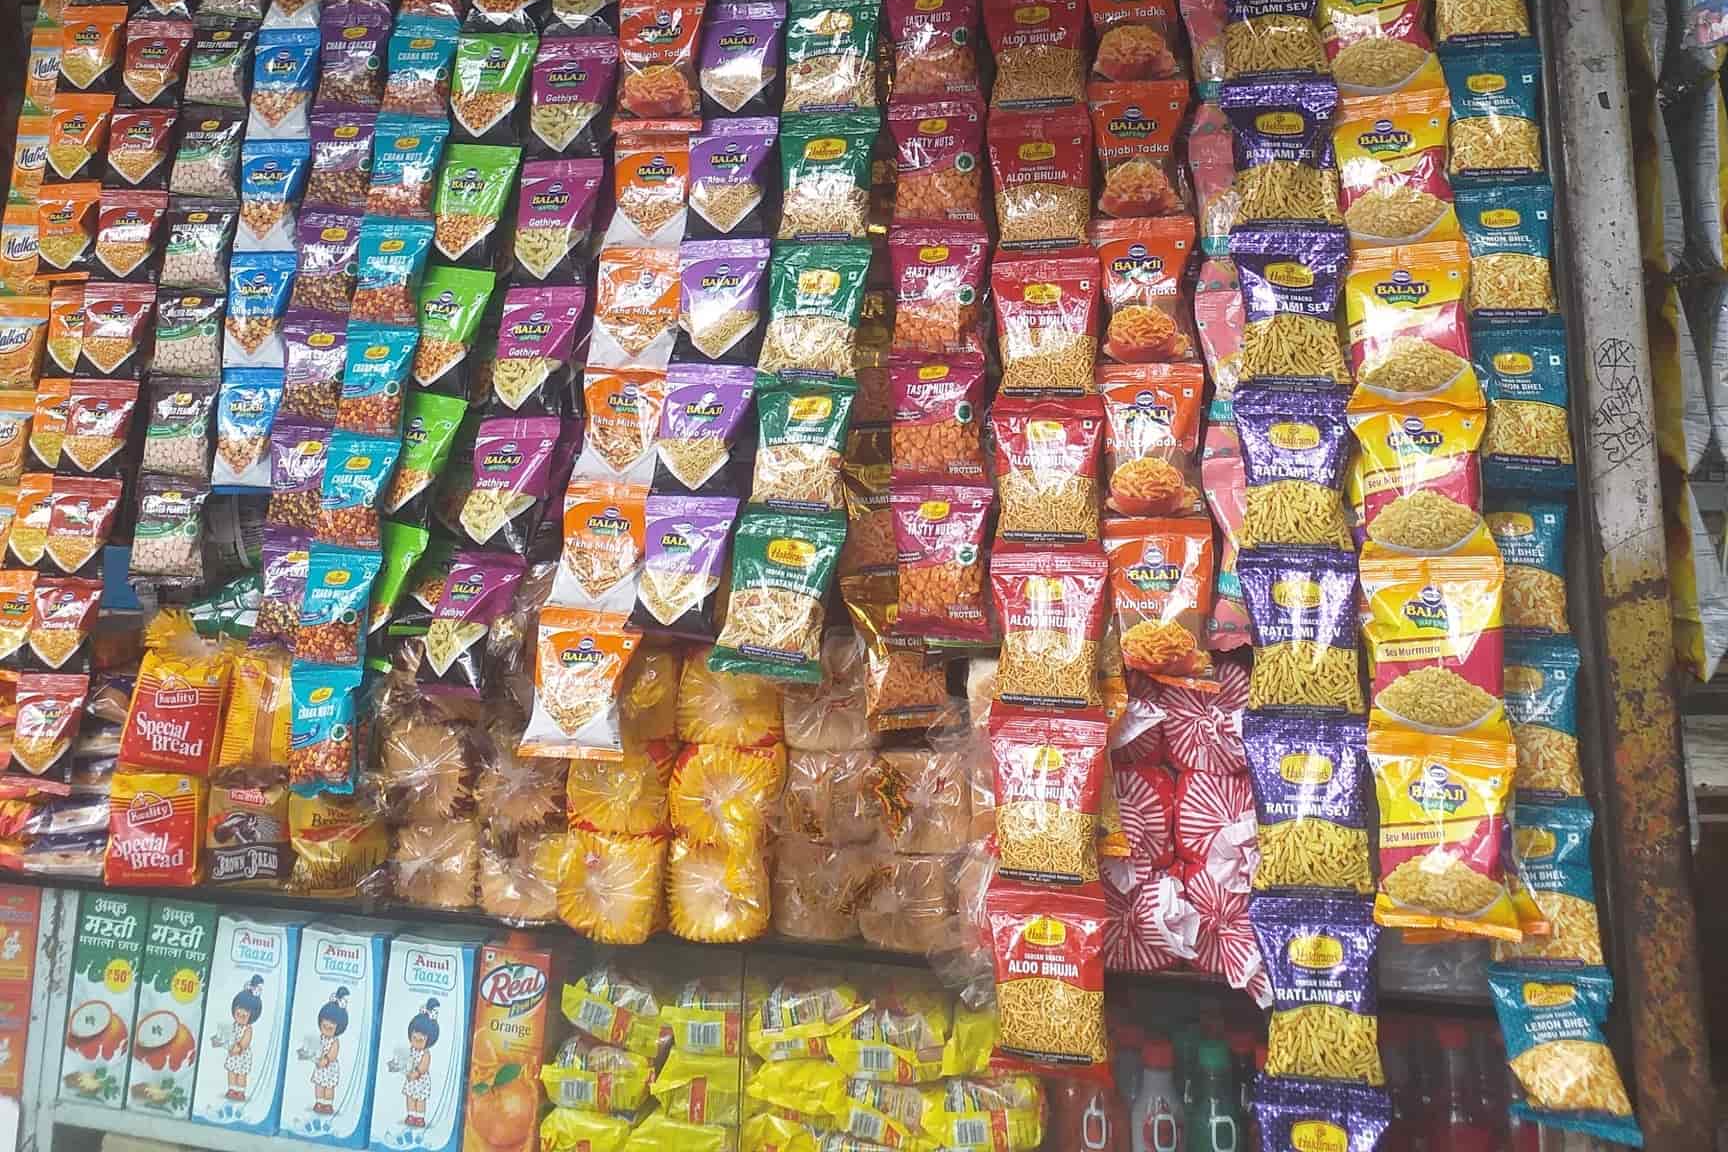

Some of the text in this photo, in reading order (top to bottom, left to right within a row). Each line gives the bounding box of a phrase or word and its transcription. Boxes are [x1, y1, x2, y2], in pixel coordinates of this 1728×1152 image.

[1235, 1, 1309, 15] RATLAMI SEV
[904, 13, 929, 26] TASTY
[547, 71, 587, 83] BALAJI
[545, 93, 579, 104] Gathiya
[1109, 121, 1158, 133] BALAJI
[933, 134, 954, 146] NUTS
[1358, 133, 1409, 147] BALAJI
[1137, 142, 1170, 154] Tadka
[637, 166, 674, 177] BALAJI
[1006, 170, 1069, 183] ALOO BHUJIA
[528, 218, 562, 228] Gathiya
[1507, 235, 1533, 243] BHEL
[1375, 283, 1430, 296] BALAJI
[1305, 301, 1331, 313] SEV
[513, 324, 552, 336] BALAJI
[508, 348, 541, 358] Gathiya
[1518, 382, 1544, 391] BHEL
[1388, 433, 1442, 448] BALAJI
[482, 454, 523, 466] BALAJI
[949, 465, 983, 474] PROTEIN
[1311, 467, 1336, 480] SEV
[588, 517, 630, 530] BALAJI
[1518, 548, 1545, 558] BHEL
[1128, 569, 1180, 582] BALAJI
[1115, 598, 1159, 611] Punjabi
[1259, 625, 1314, 639] RATLAMI
[562, 651, 603, 663] BALAJI
[136, 711, 190, 742] Special
[152, 730, 203, 758] Bread
[1325, 804, 1351, 817] SEV
[112, 832, 169, 860] Special
[131, 848, 184, 870] Bread
[1539, 870, 1568, 881] BHEL
[85, 914, 137, 940] मस्ती
[151, 923, 206, 949] मस्ती
[239, 930, 274, 949] Amul
[324, 944, 360, 960] Amul
[323, 956, 360, 974] Taaza
[415, 954, 450, 971] Amul
[1007, 960, 1079, 977] ALOO BHUJIA
[412, 967, 450, 985] Taaza
[488, 971, 543, 1005] Real
[1276, 988, 1362, 1003] RATLAMI SEV
[490, 1018, 533, 1037] Orange
[1524, 1017, 1591, 1033] LEMON BHEL
